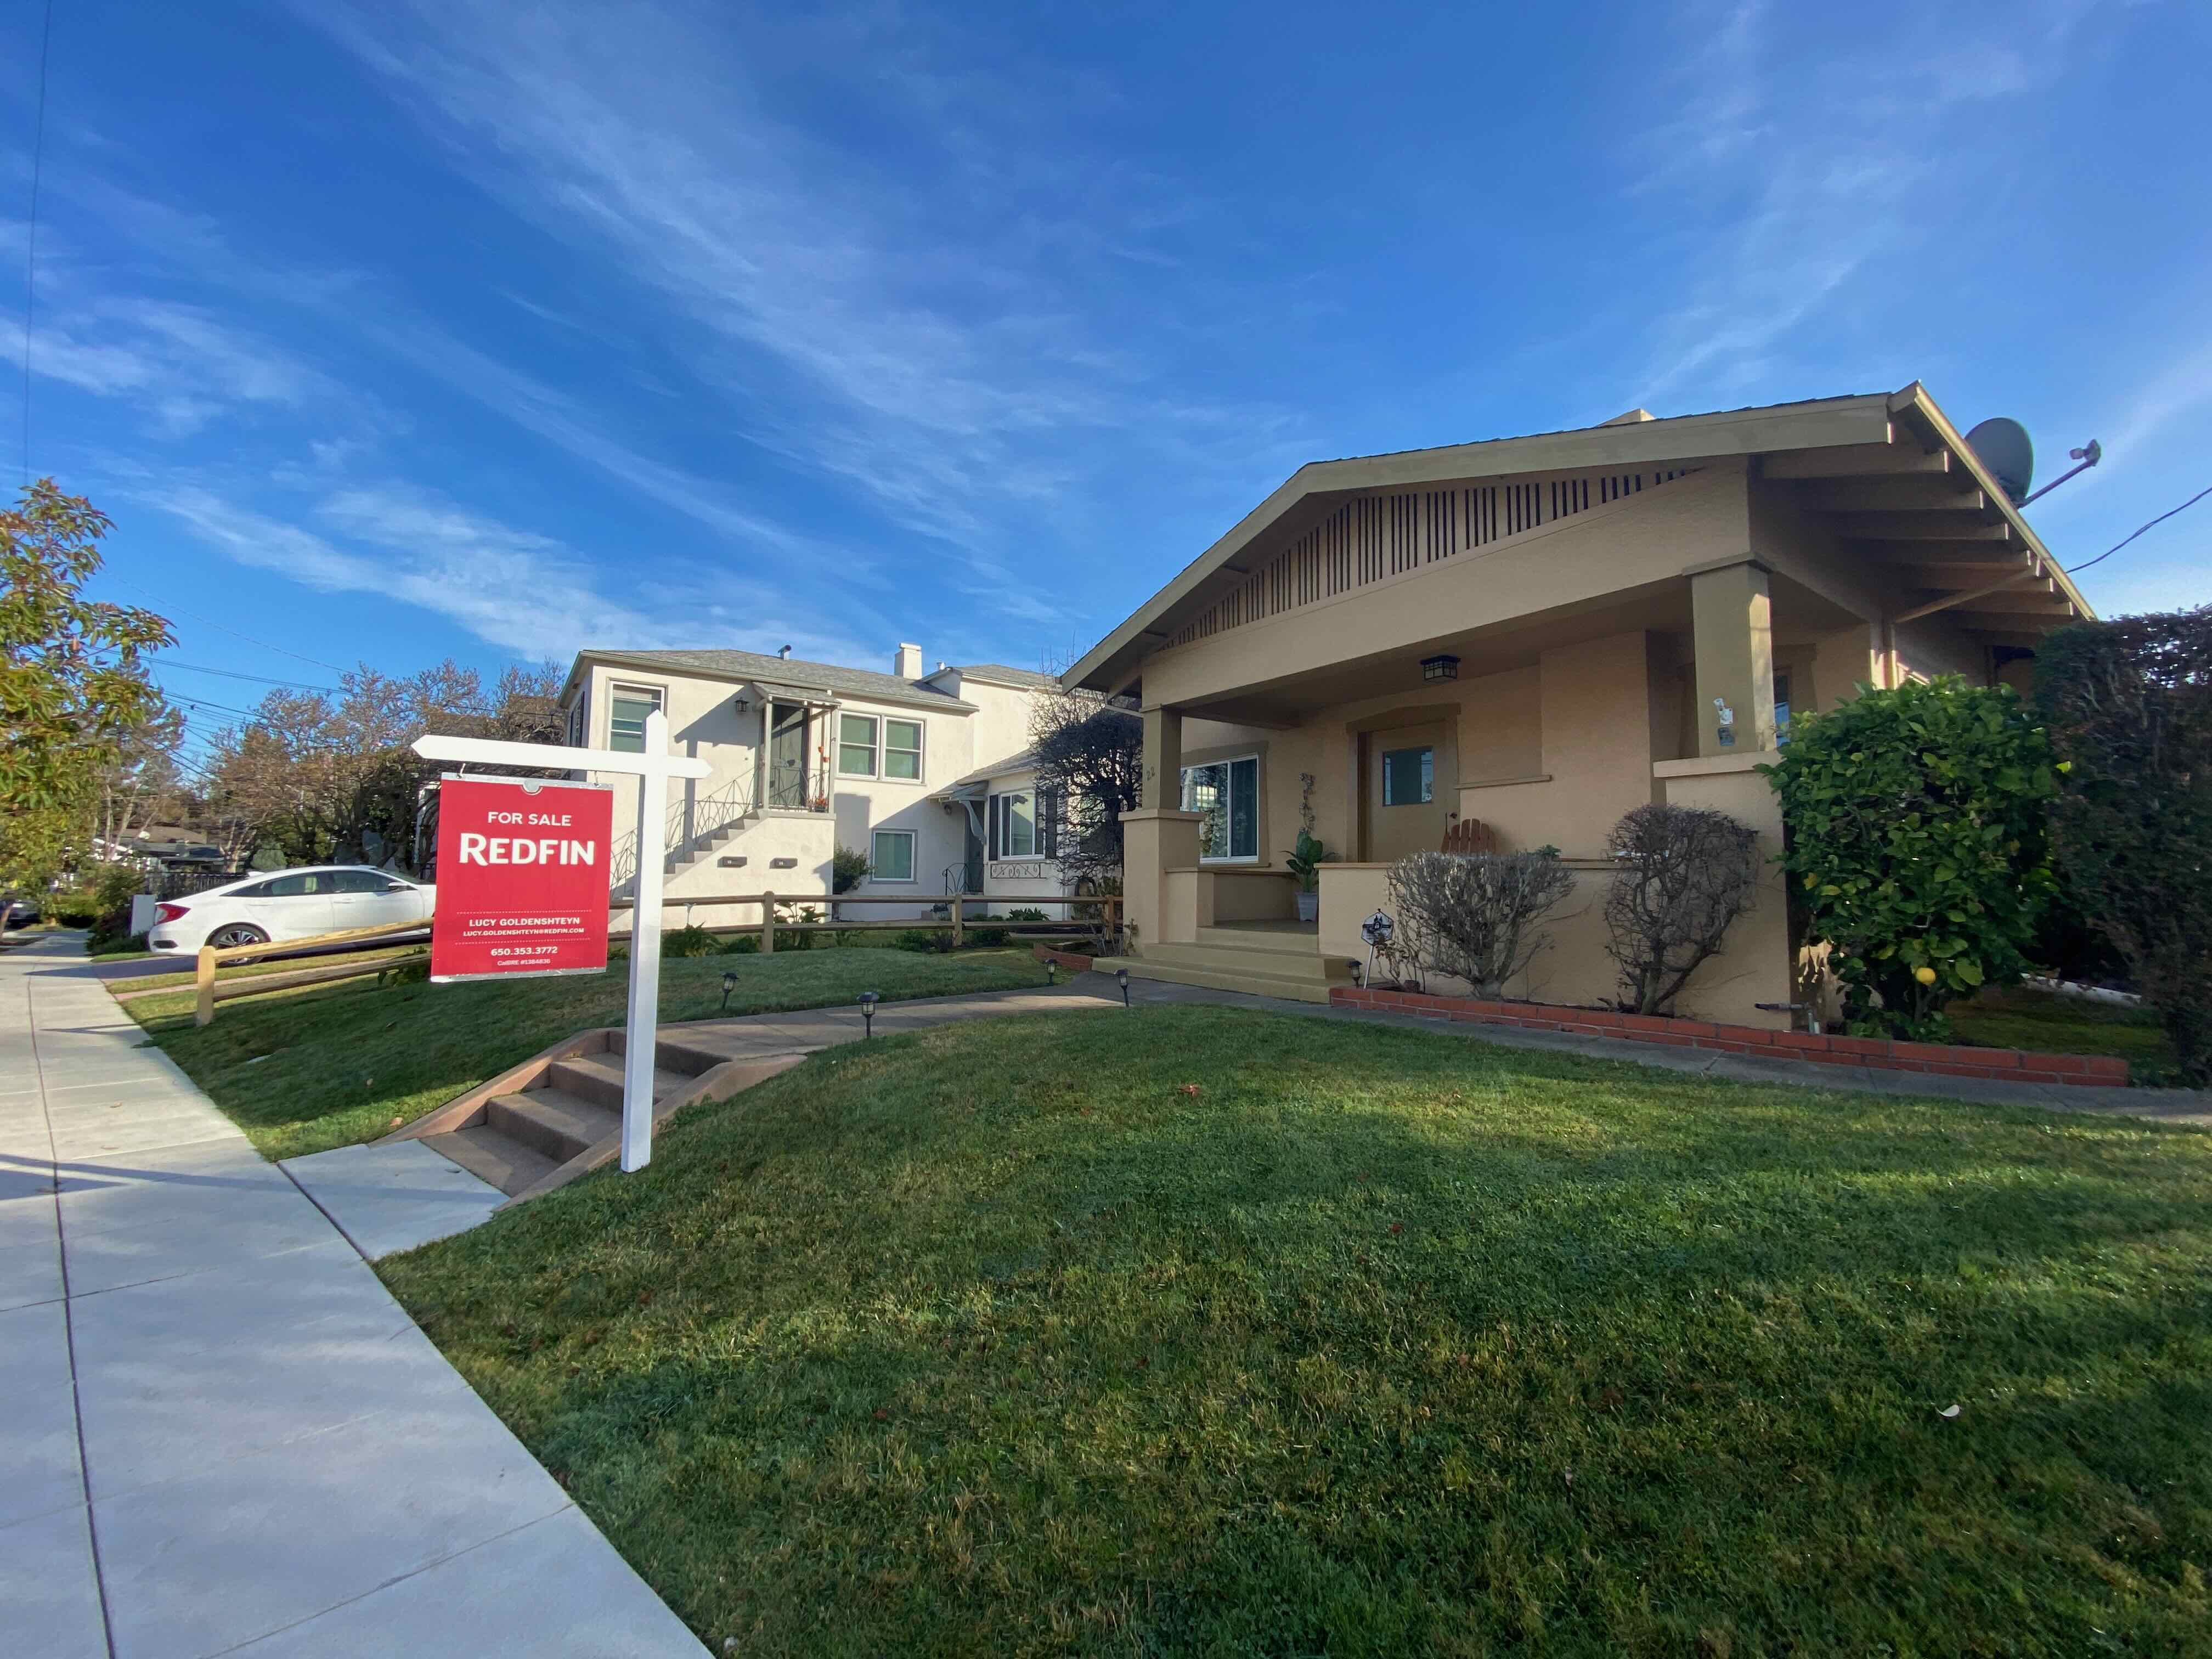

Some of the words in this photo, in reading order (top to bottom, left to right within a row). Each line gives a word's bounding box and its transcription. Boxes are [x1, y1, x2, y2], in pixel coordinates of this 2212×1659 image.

[488, 811, 523, 825] FOR
[528, 813, 572, 826] SALE
[459, 833, 595, 866] REDFIN
[469, 919, 496, 927] LUCY
[499, 917, 580, 926] GOLDENSHTEYN
[463, 928, 584, 936] LUCY.GOLDENSHTEYN@REDFIN.COM
[490, 946, 558, 956] 650.353.3772
